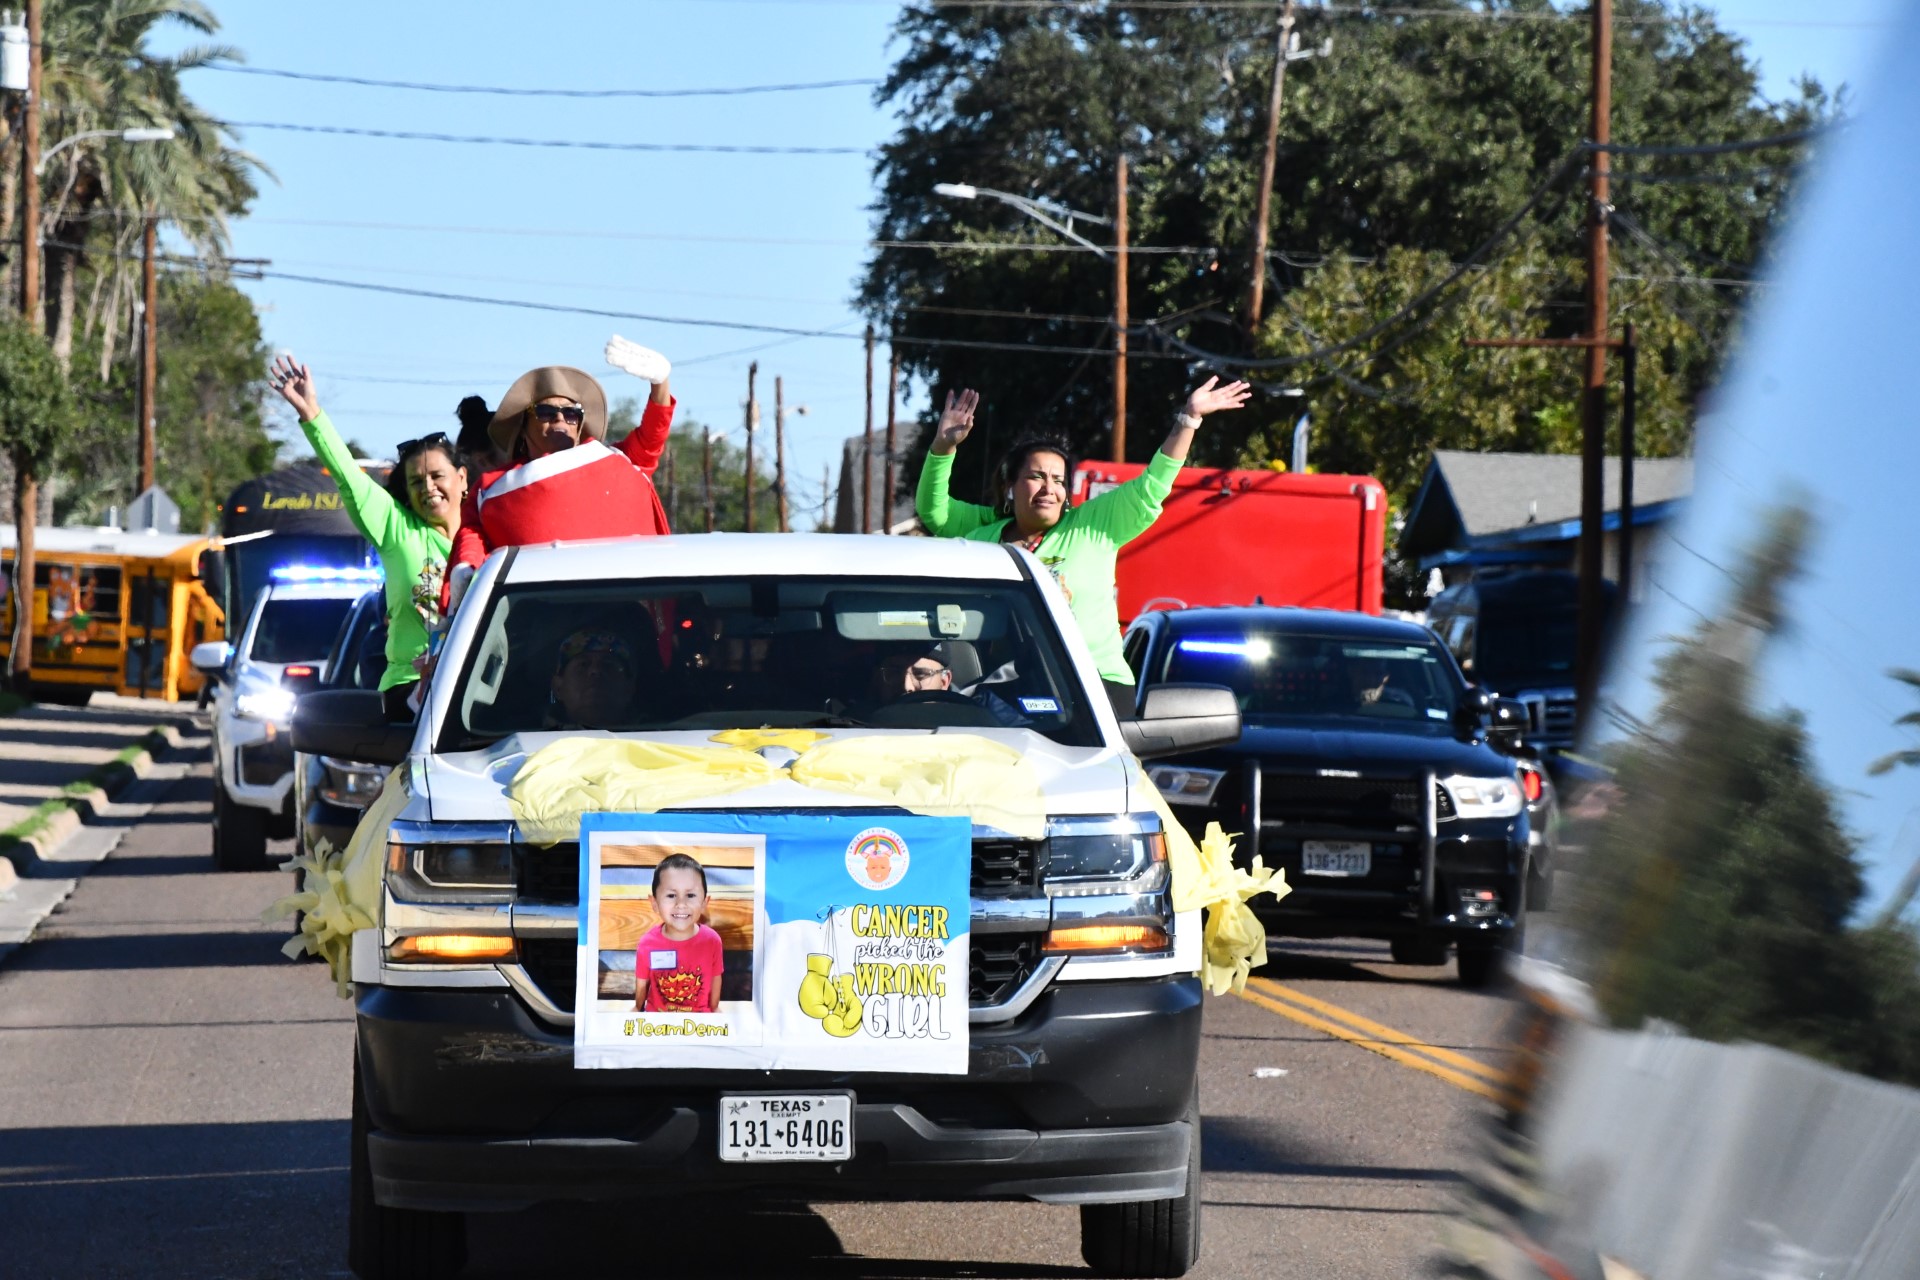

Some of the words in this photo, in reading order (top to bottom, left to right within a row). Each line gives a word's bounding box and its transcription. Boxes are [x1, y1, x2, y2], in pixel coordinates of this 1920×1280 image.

[851, 903, 950, 940] CANCER
[853, 936, 912, 967] picked
[911, 936, 945, 961] the
[854, 962, 946, 998] WRONG
[624, 1018, 729, 1038] #TeamDemi
[862, 991, 951, 1041] GIRL
[760, 1100, 812, 1112] TEXAS
